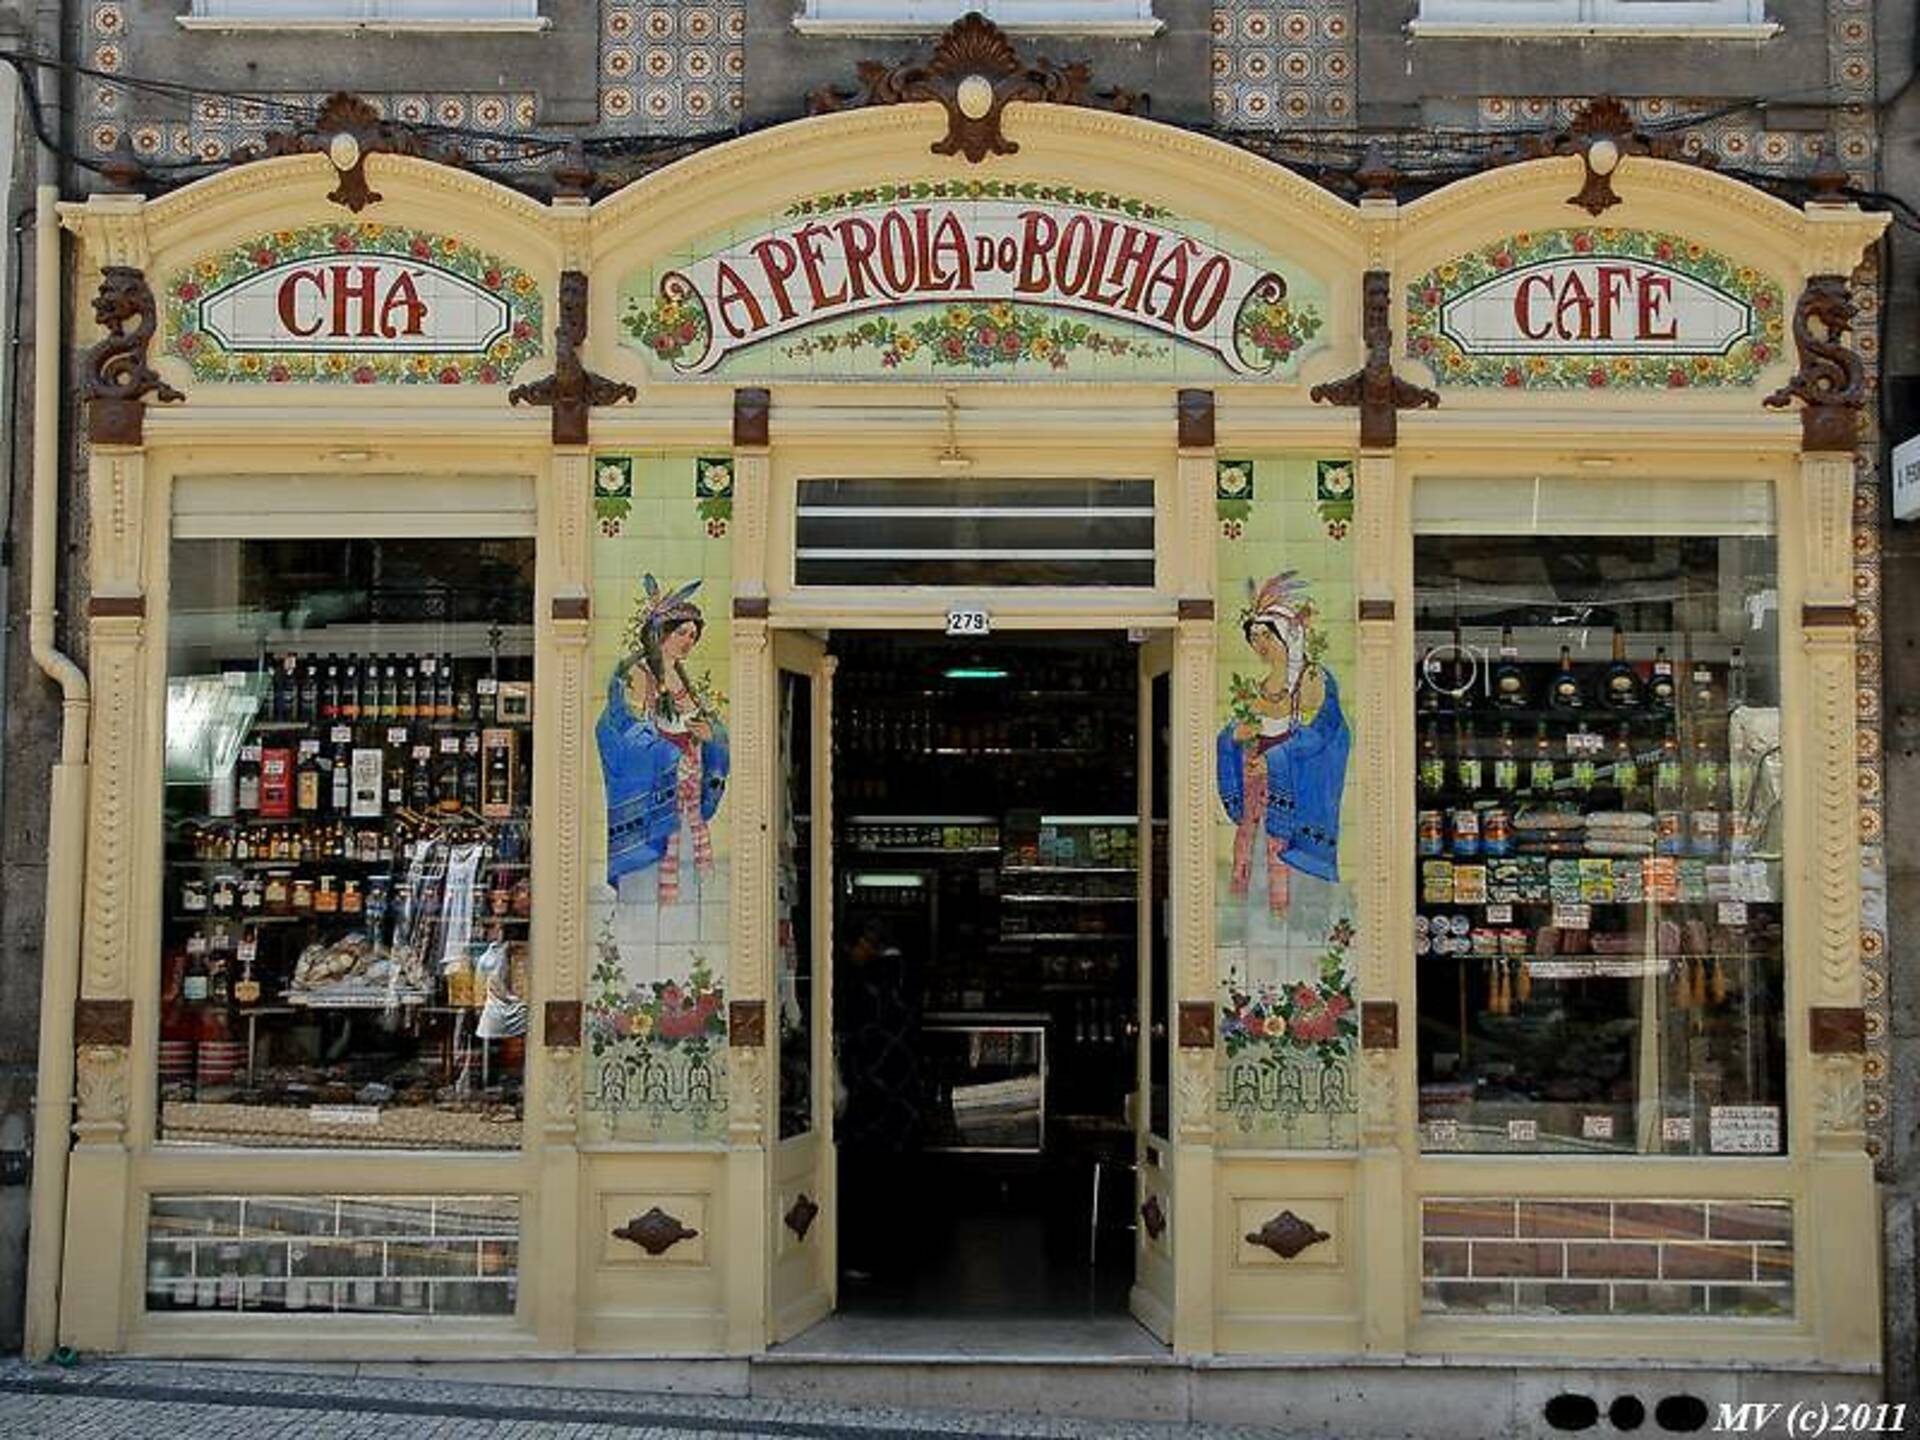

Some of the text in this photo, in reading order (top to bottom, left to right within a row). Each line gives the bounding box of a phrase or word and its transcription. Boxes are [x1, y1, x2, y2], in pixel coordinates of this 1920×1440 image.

[278, 266, 427, 338] CHÁ
[717, 260, 769, 338] A
[750, 207, 974, 321] PÉROLA
[1013, 210, 1231, 332] BOLHÃO
[1514, 266, 1677, 341] CAFÉ
[952, 614, 983, 629] 279
